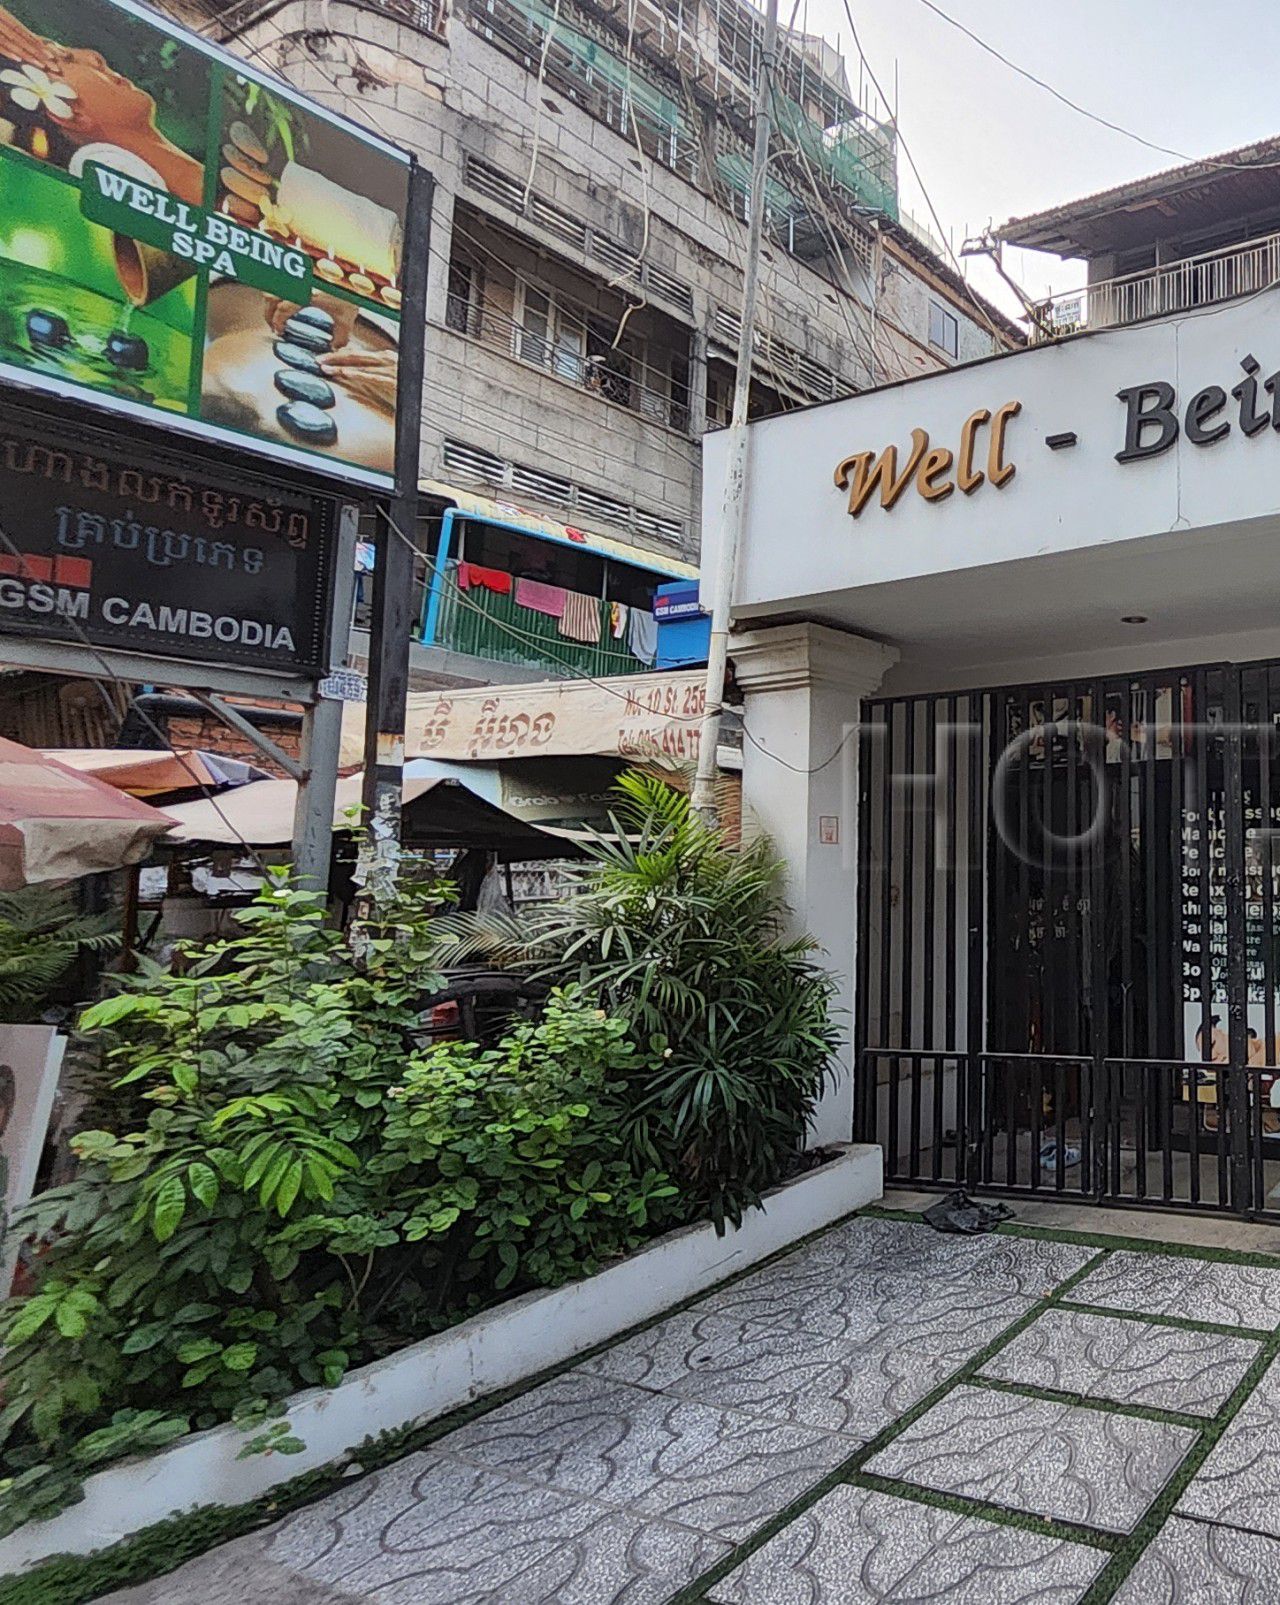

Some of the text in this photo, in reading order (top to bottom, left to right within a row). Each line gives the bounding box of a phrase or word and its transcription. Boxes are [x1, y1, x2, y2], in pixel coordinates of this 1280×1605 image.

[95, 167, 306, 279] WELL BEING
[172, 232, 237, 276] SPA
[834, 401, 1021, 518] Well
[0, 578, 297, 652] GSM CAMBODIA
